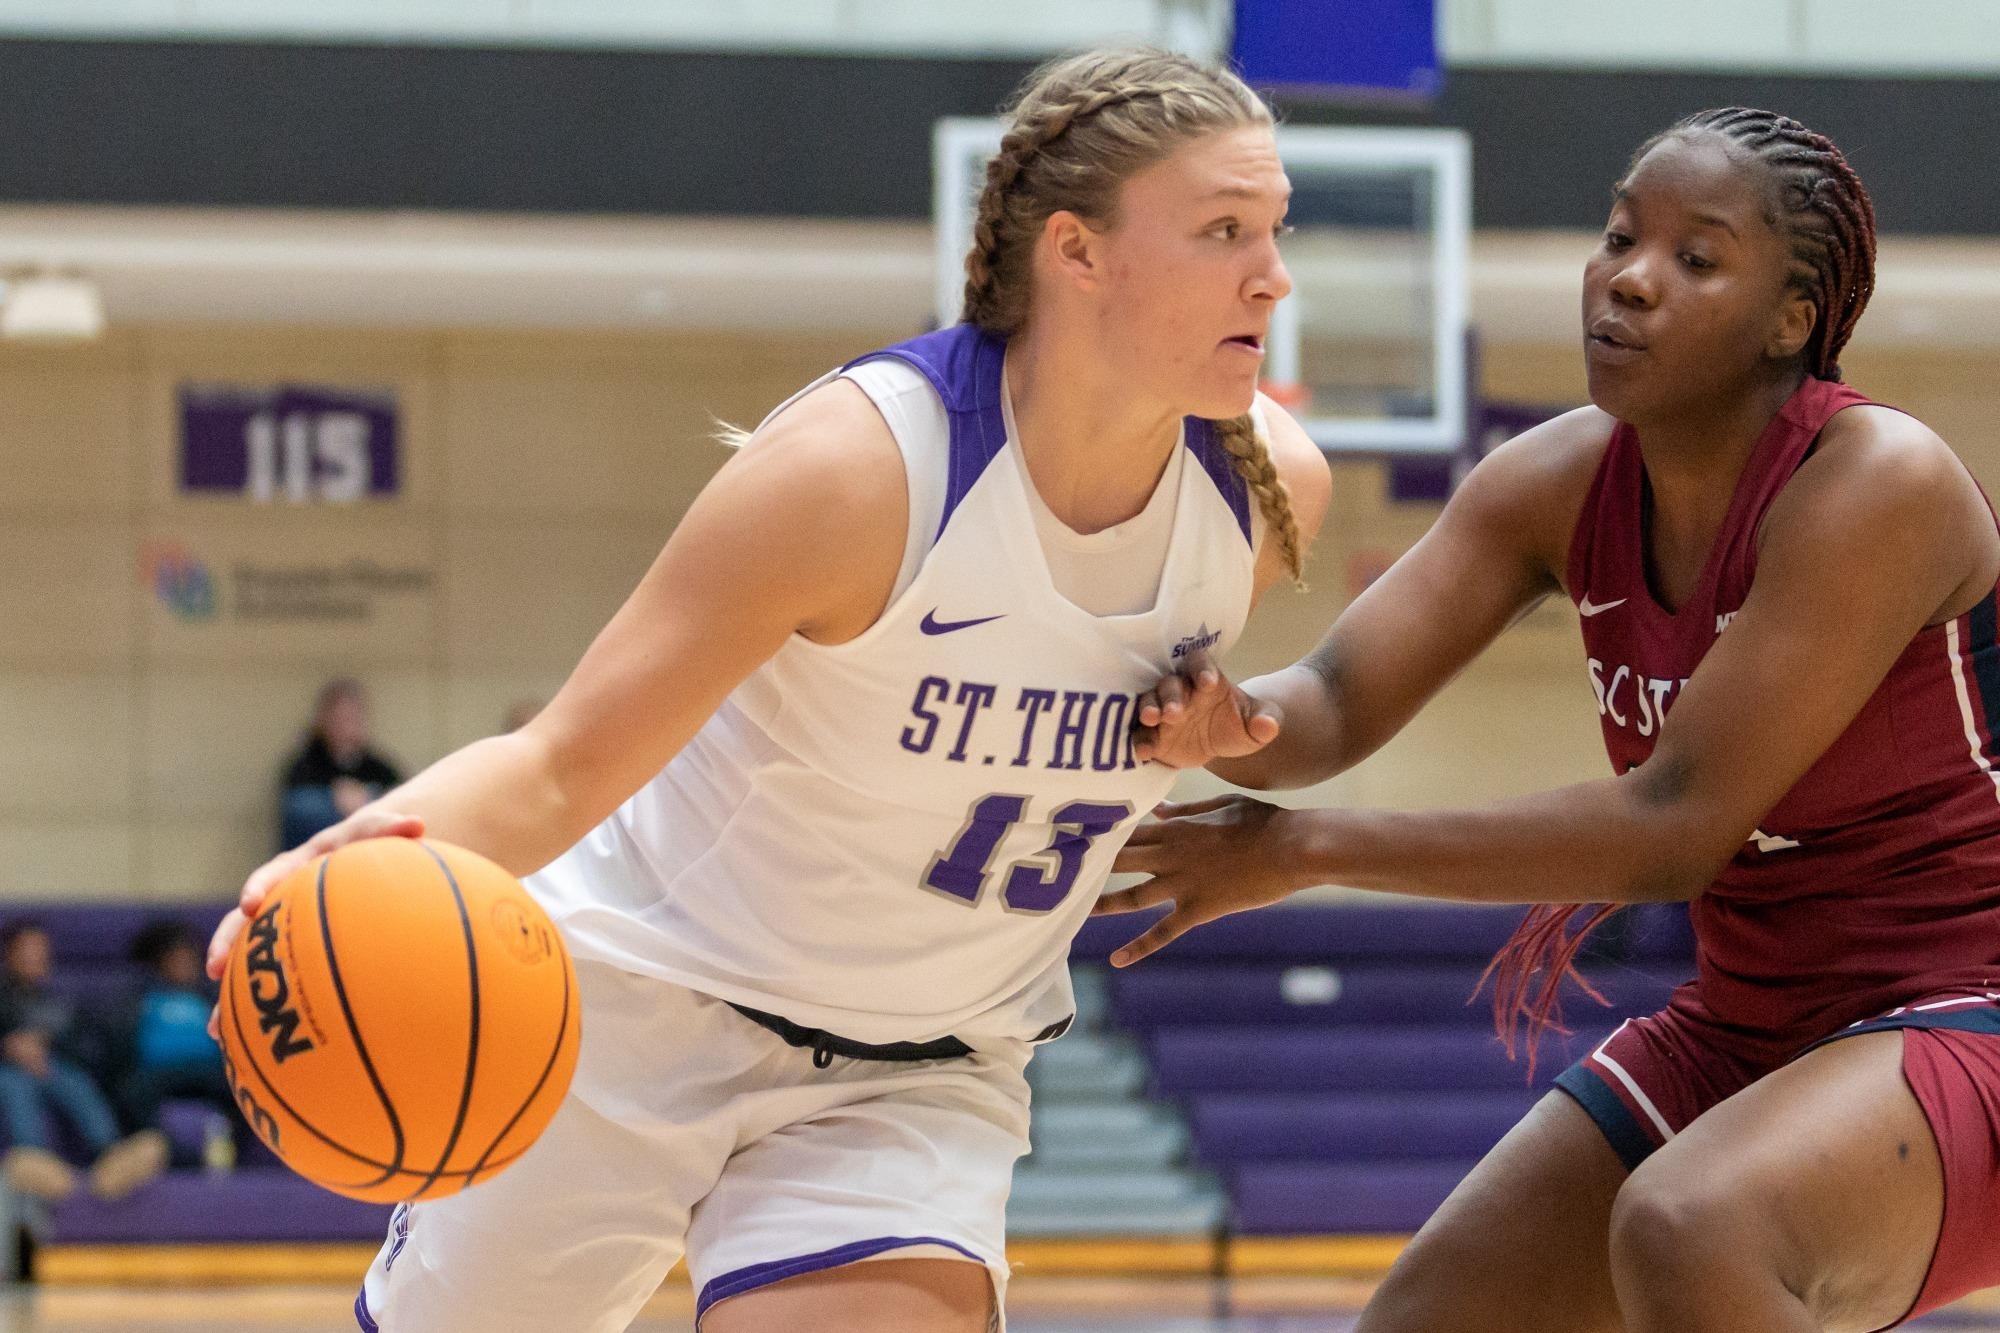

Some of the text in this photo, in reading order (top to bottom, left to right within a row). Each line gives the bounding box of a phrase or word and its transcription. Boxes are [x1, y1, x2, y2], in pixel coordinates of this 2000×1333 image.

[247, 412, 370, 501] 115
[1172, 629, 1222, 658] SUMMIT
[1637, 674, 1690, 736] ST
[918, 792, 1137, 916] 13
[247, 902, 314, 1064] NCAA
